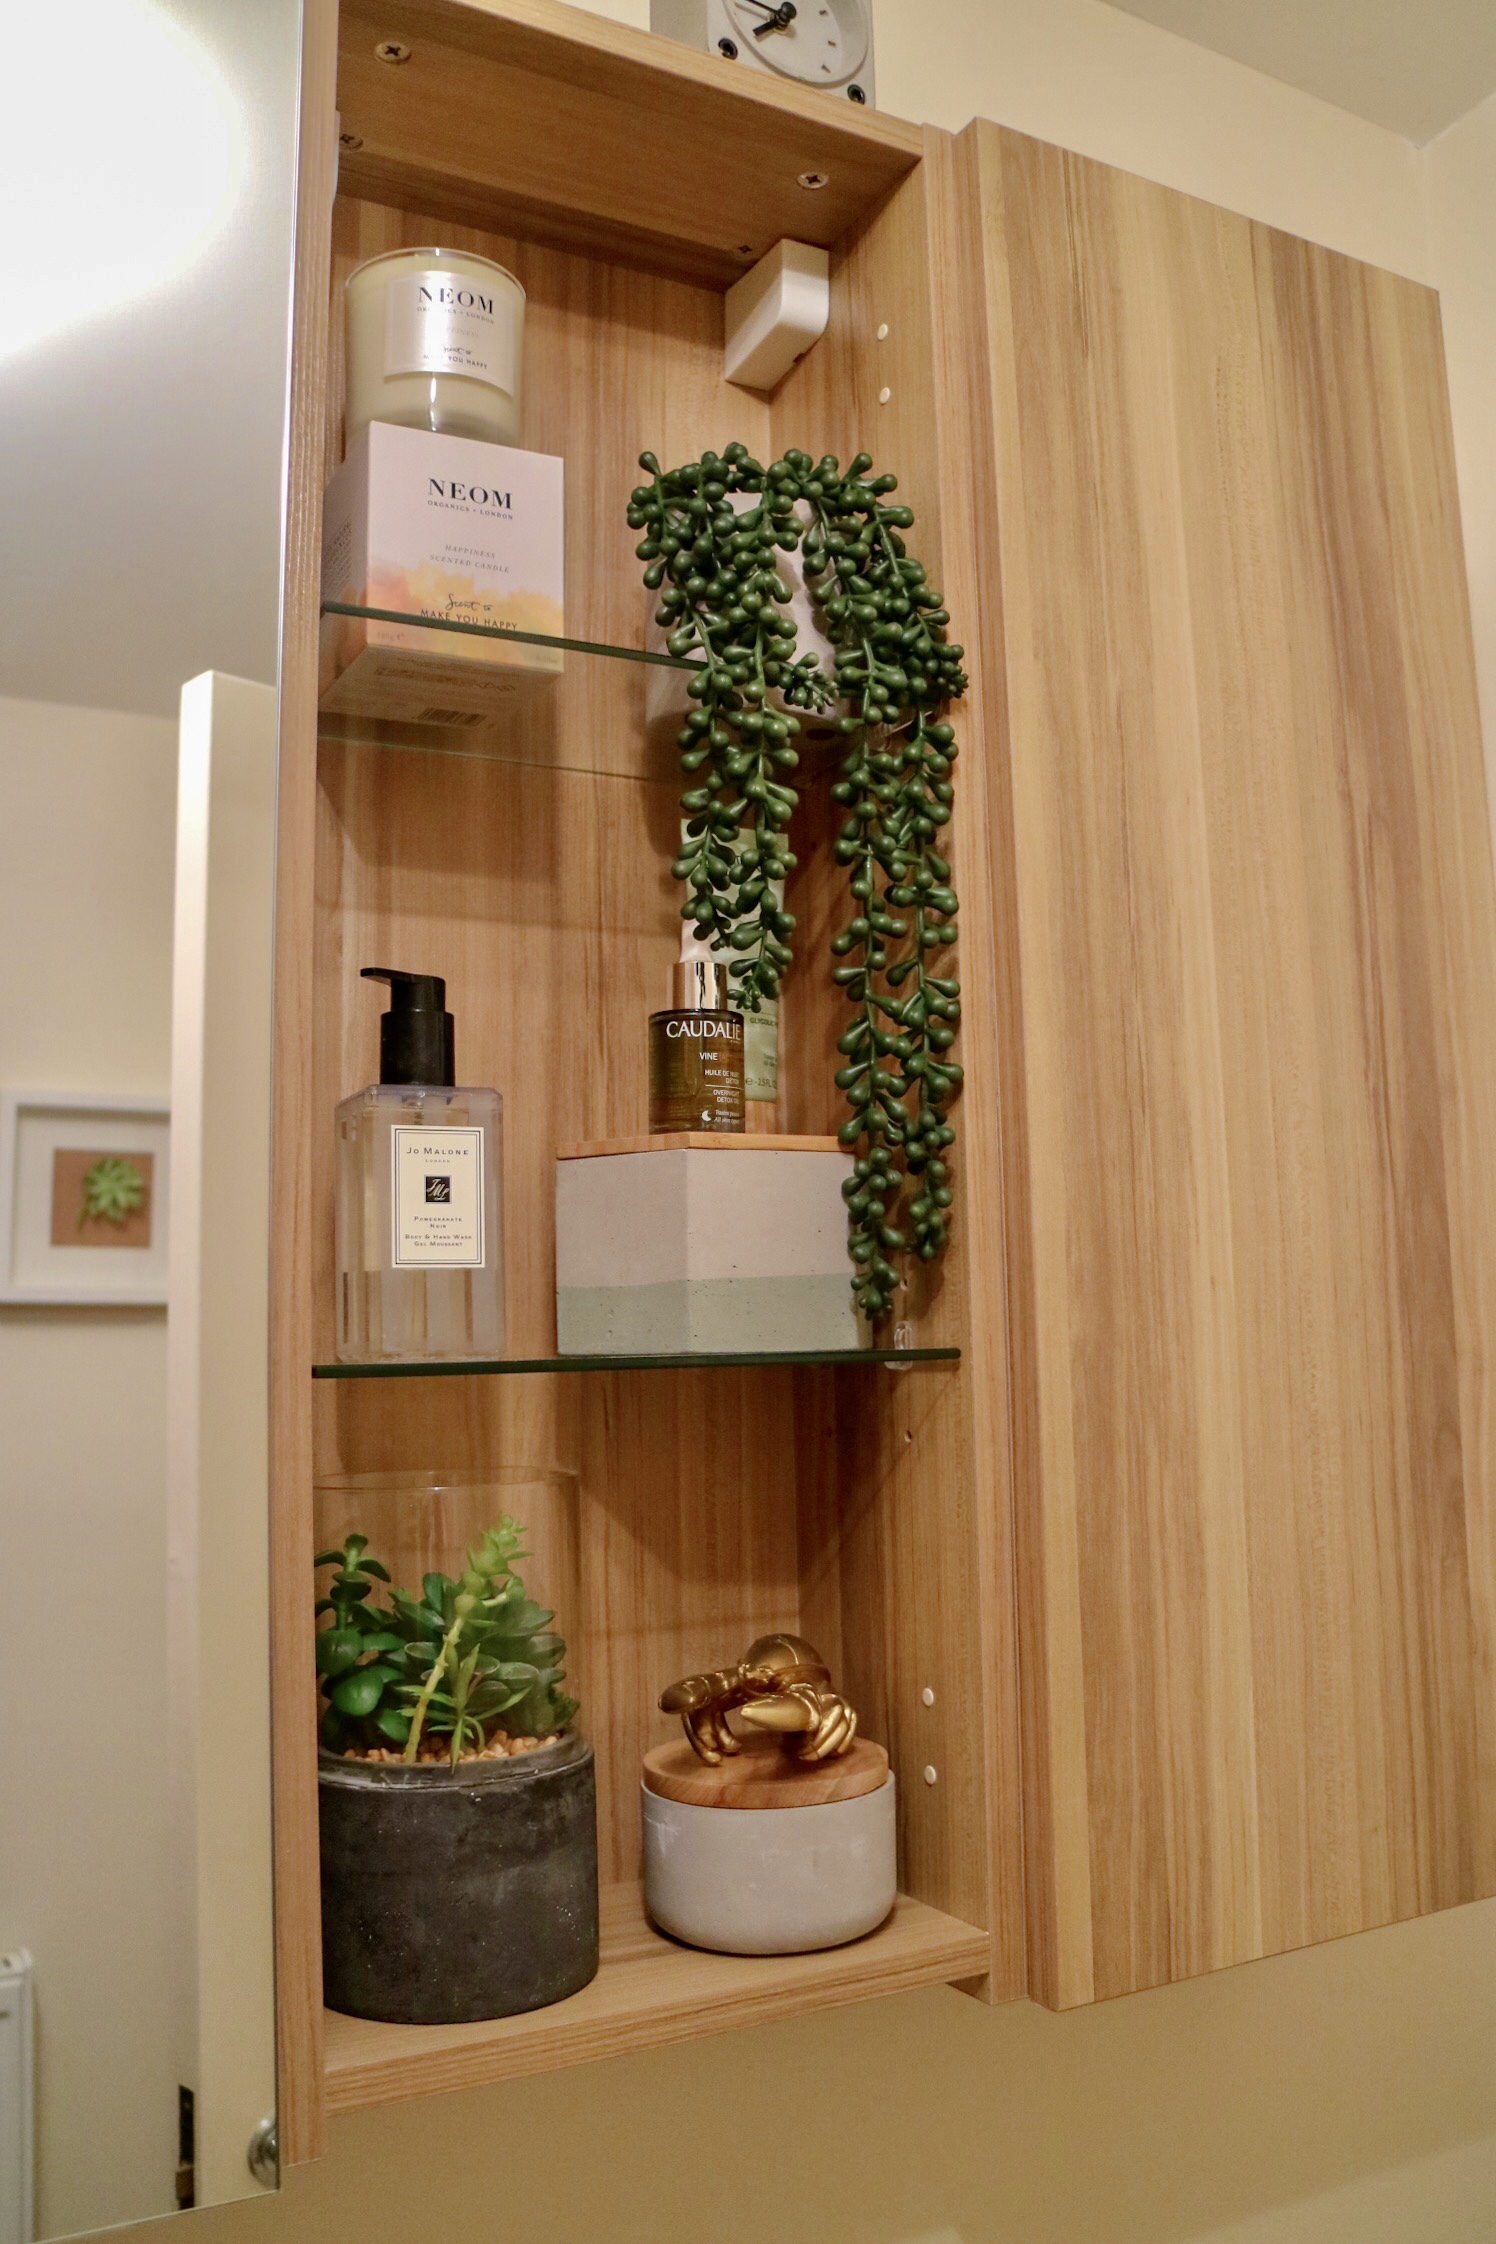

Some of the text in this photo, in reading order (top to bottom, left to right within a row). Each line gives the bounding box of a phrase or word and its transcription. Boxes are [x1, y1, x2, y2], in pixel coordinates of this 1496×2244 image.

[418, 287, 493, 315] NEOM
[416, 306, 494, 324] ORICS LONDON
[448, 356, 463, 364] YOU
[466, 359, 487, 369] HAPPY
[427, 477, 513, 510] NEOM
[427, 499, 514, 520] ORGANICS LONDON
[445, 544, 496, 559] HAPPINESS
[429, 553, 511, 574] SCENTED CANDLE
[445, 592, 494, 612] Scent to
[420, 608, 518, 631] MAKE YOU HAPPY
[699, 1052, 718, 1061] VINE
[704, 1069, 722, 1077] HUILE
[716, 1096, 733, 1104] DETOX
